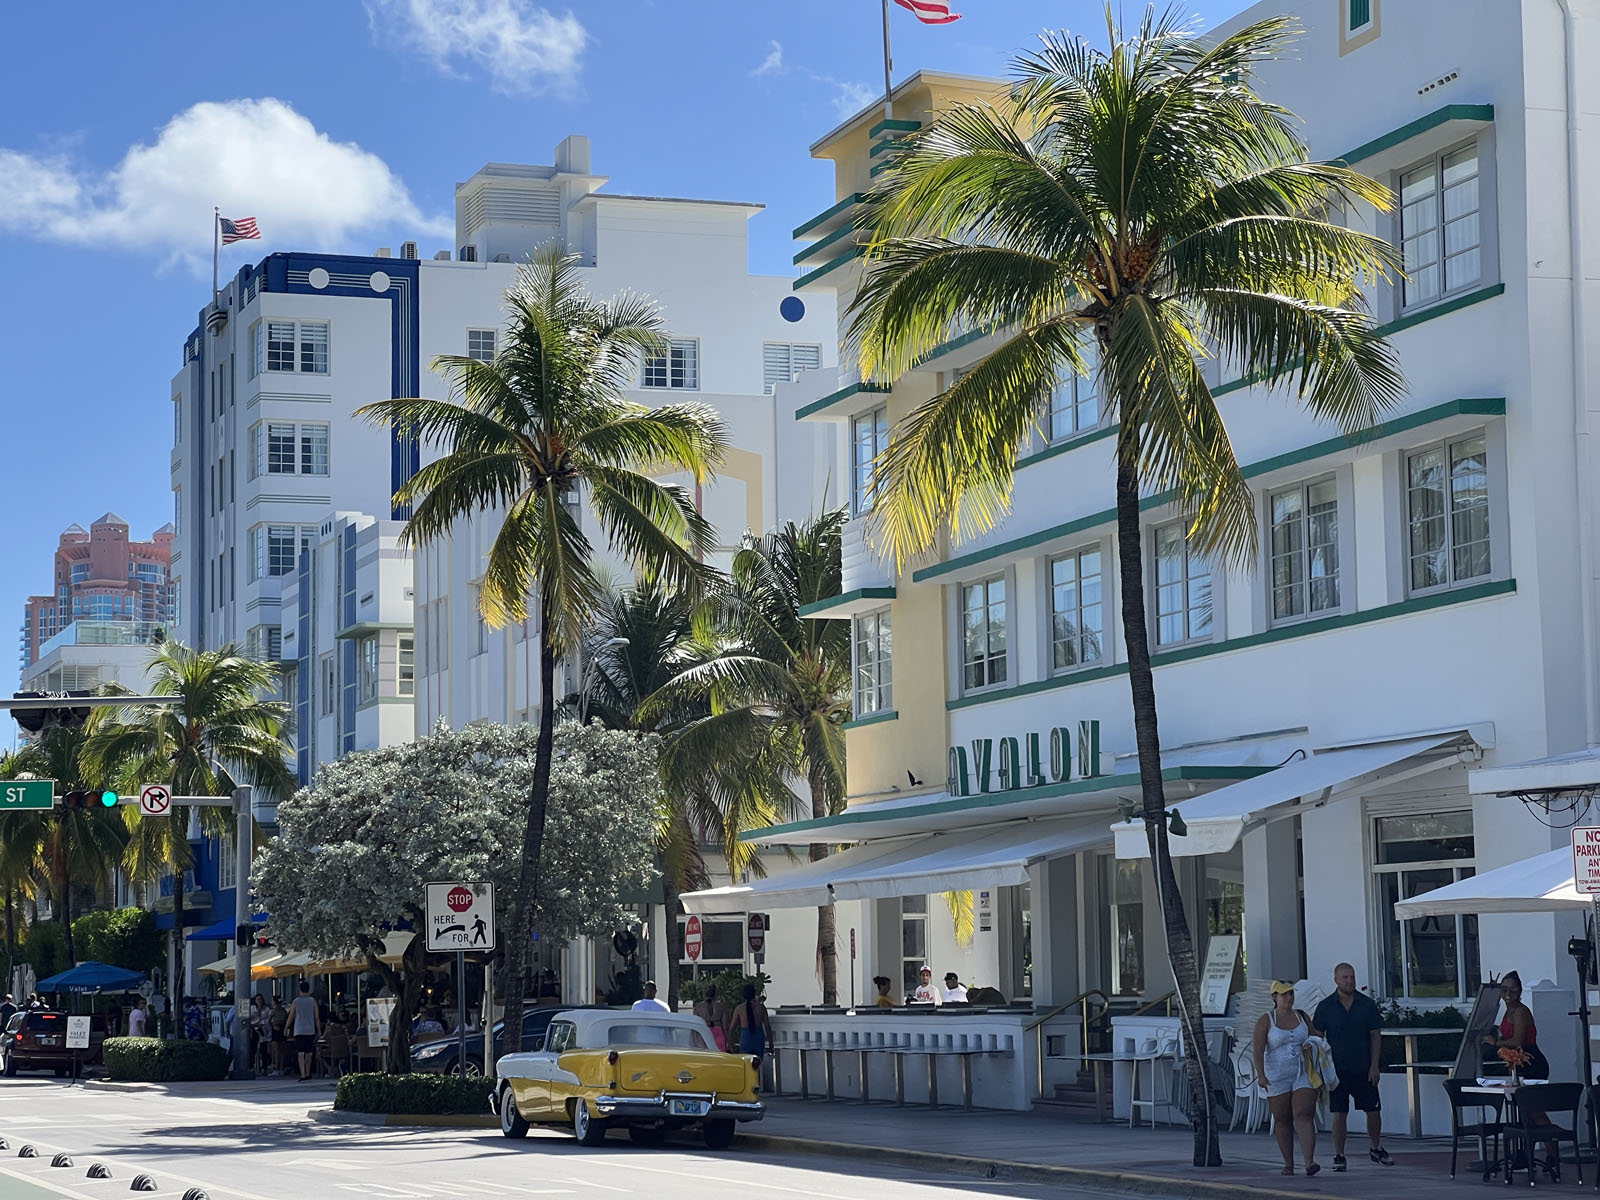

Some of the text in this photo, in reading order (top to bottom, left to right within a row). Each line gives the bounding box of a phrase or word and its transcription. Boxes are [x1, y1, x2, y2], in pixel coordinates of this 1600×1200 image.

[947, 719, 1100, 797] AVALON
[6, 787, 26, 802] ST
[448, 894, 472, 905] STOP
[434, 915, 456, 924] HERE
[452, 934, 469, 943] FOR
[688, 944, 699, 952] ENTER
